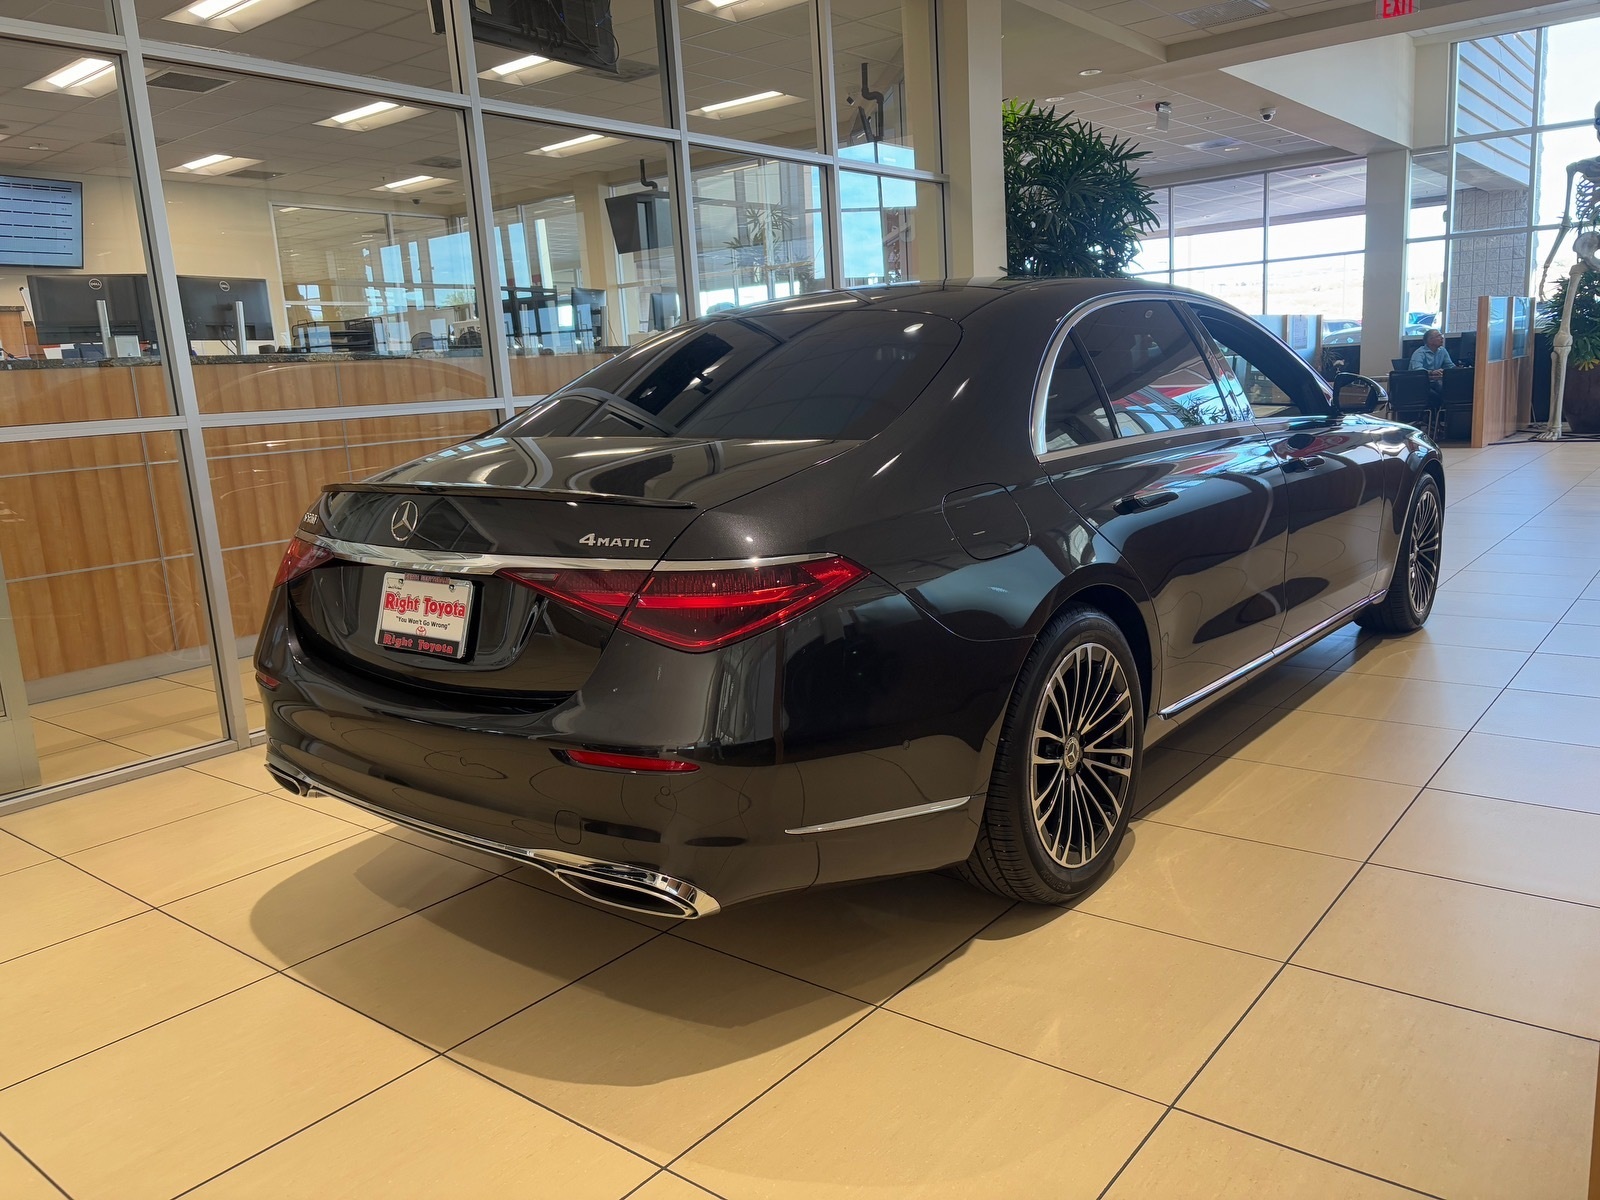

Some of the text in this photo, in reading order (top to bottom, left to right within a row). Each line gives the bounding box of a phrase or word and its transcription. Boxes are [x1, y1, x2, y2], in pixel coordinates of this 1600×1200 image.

[579, 533, 651, 548] 4MATIC
[384, 591, 466, 619] Right Toyota
[407, 618, 422, 626] Won't
[422, 619, 430, 627] Go
[383, 633, 453, 654] Right Toyota
